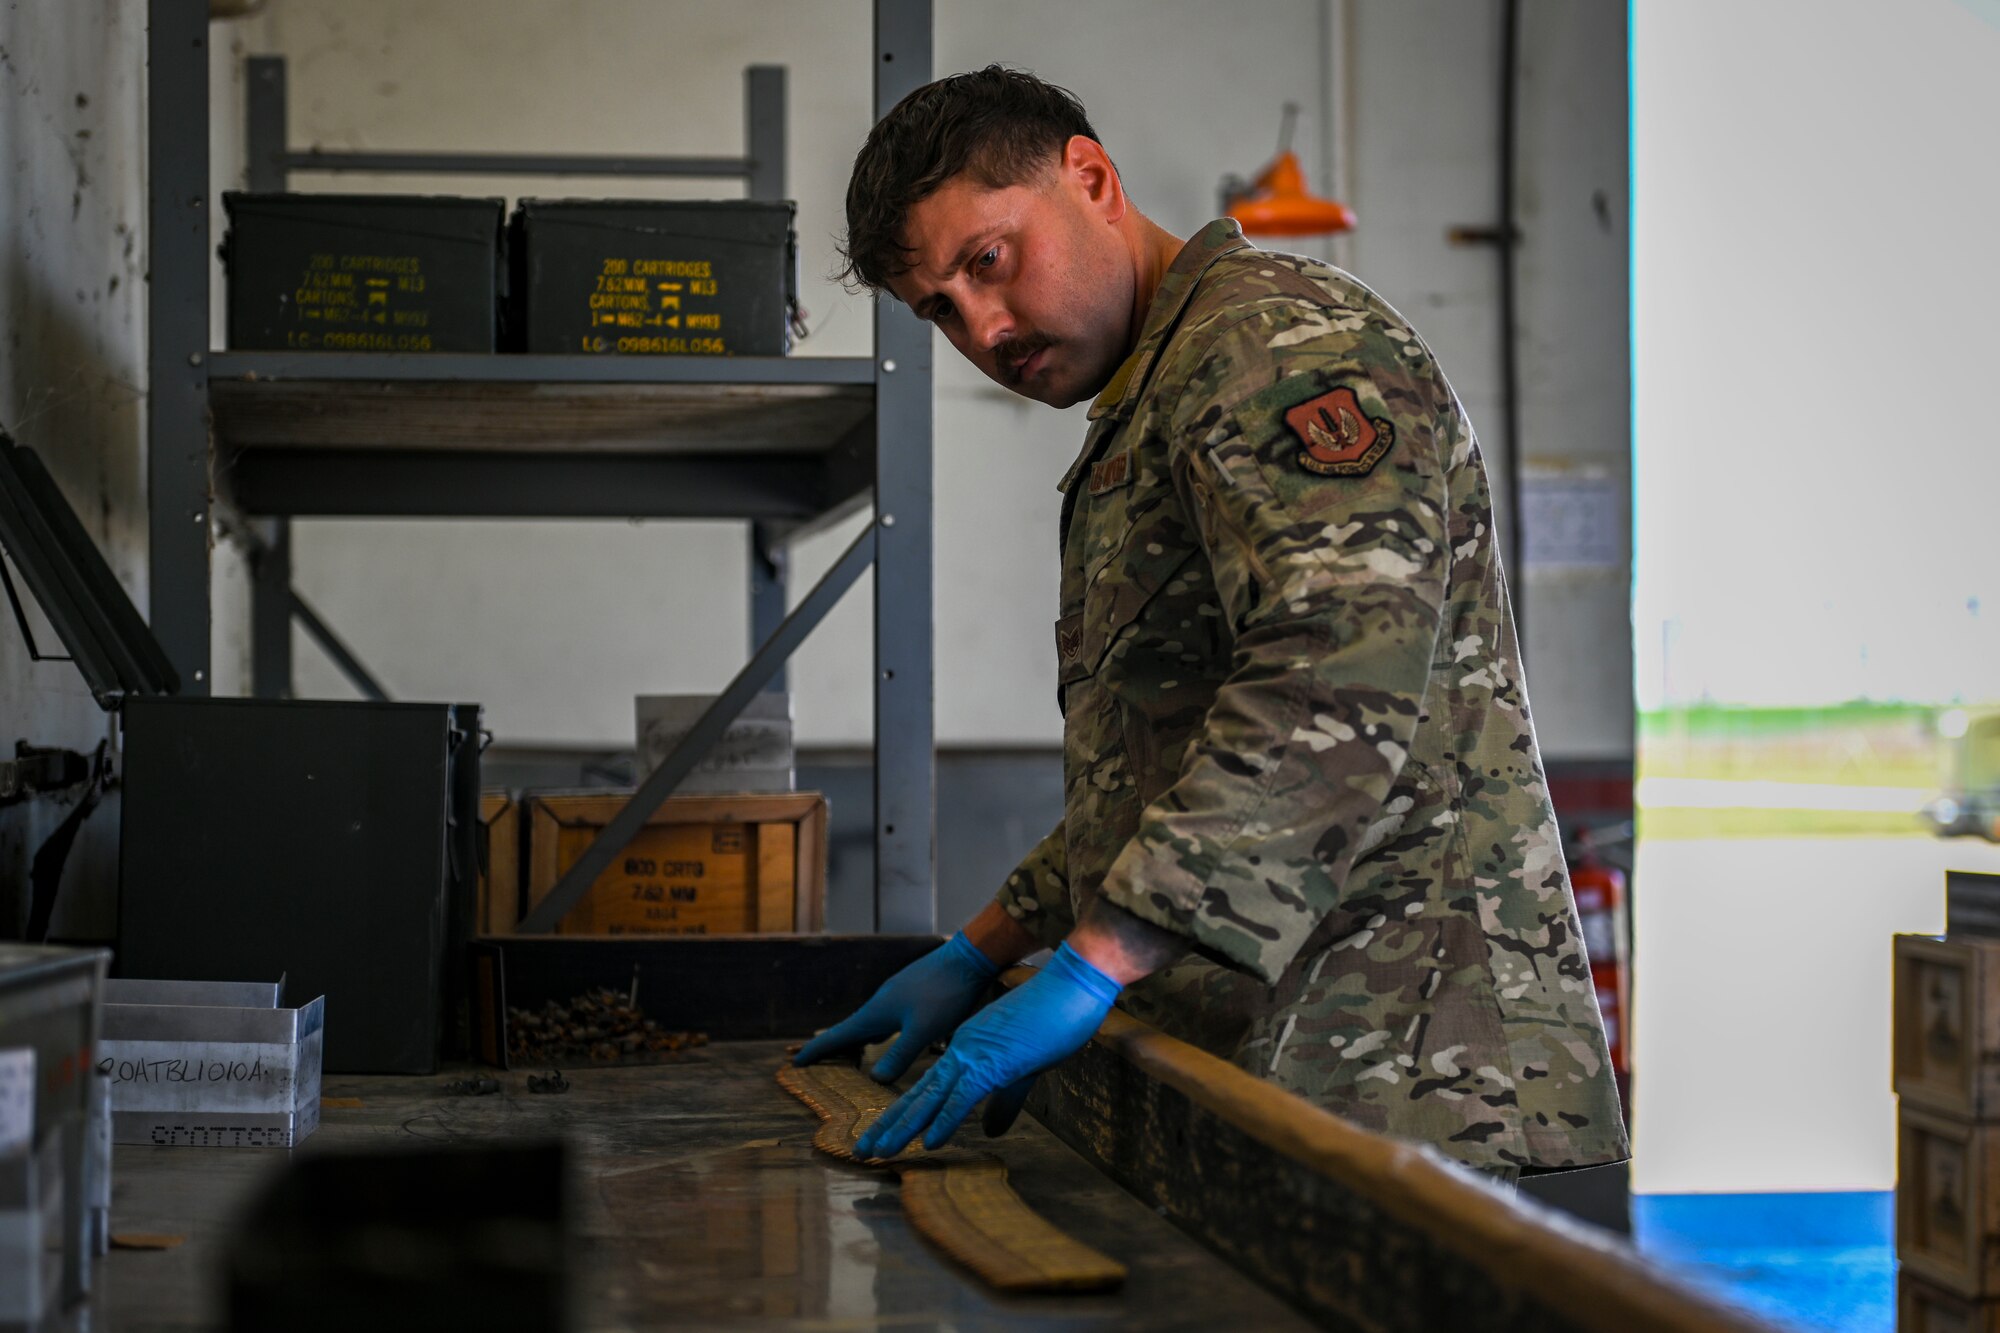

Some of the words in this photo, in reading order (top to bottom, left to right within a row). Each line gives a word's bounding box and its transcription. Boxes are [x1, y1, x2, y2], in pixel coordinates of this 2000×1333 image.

[310, 255, 334, 270] 200
[340, 256, 420, 273] CARTRIDGES
[603, 259, 627, 275] 200
[633, 260, 712, 277] CARTRIDGES
[398, 275, 426, 291] M13
[689, 280, 718, 296] M13
